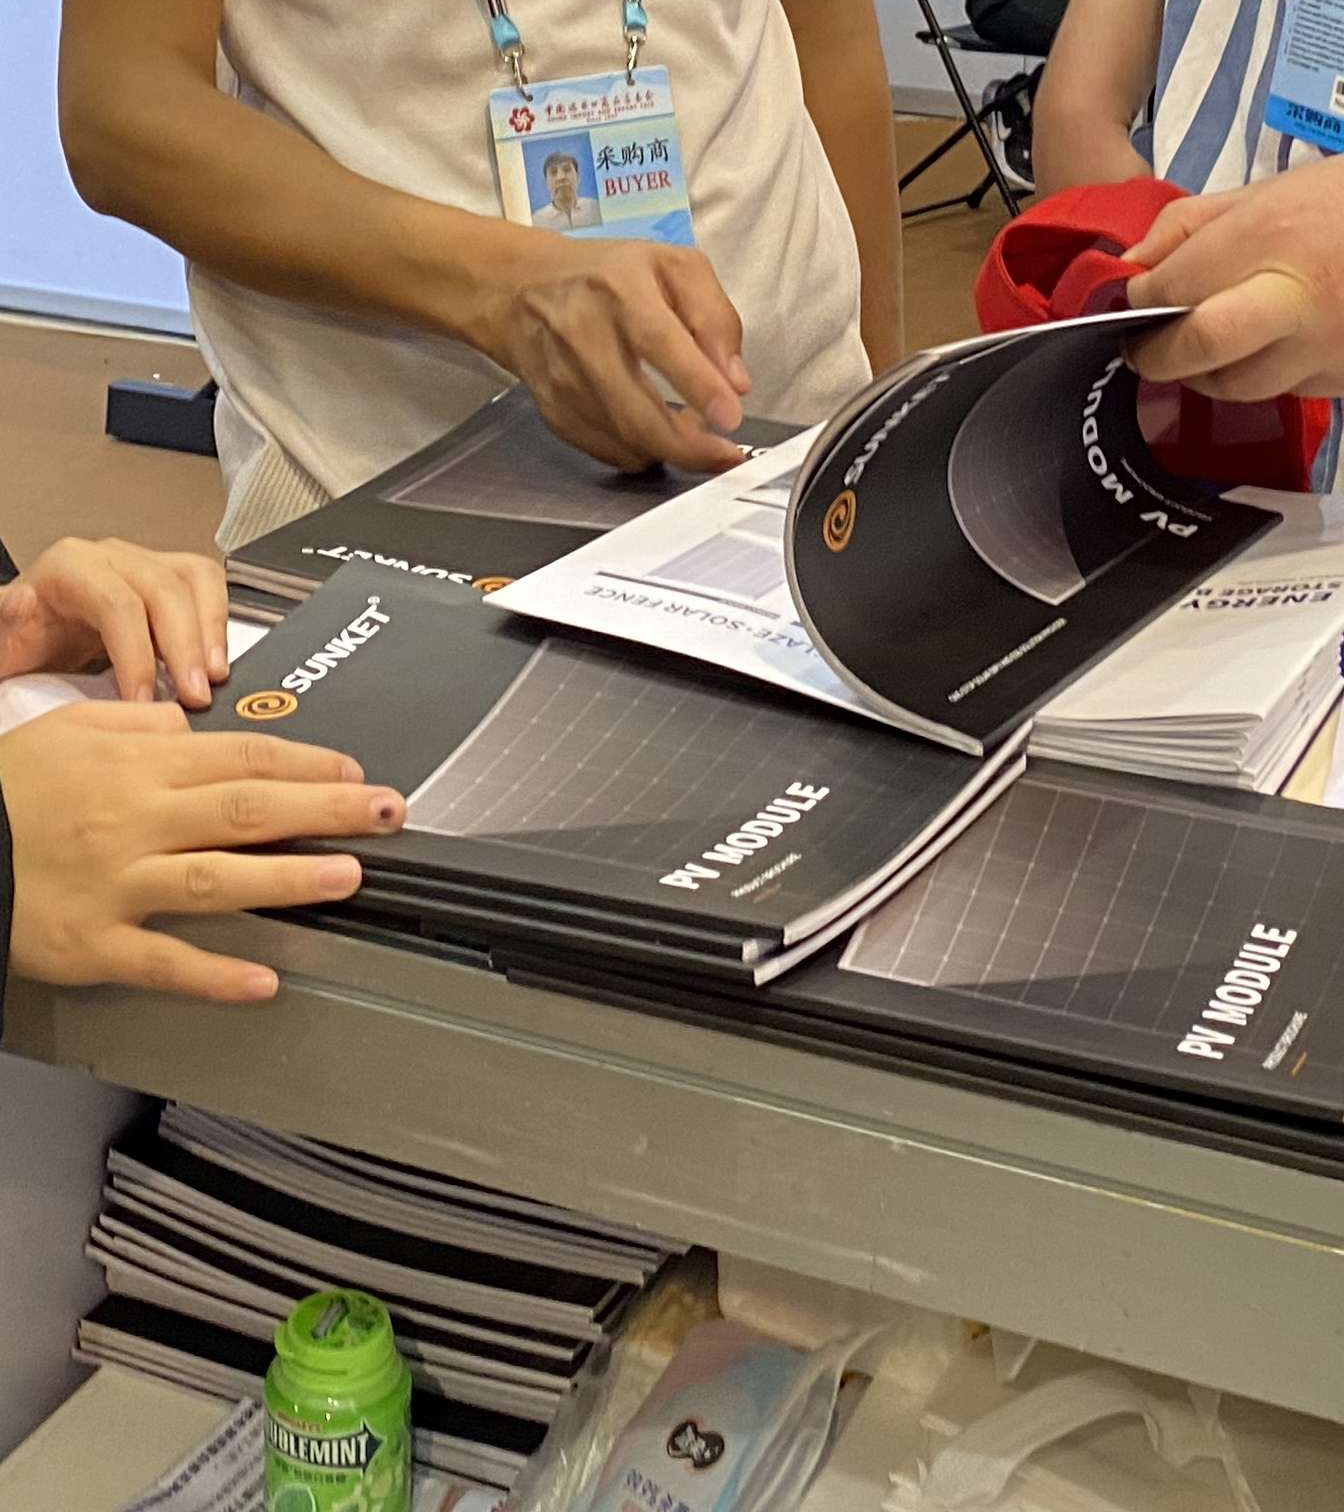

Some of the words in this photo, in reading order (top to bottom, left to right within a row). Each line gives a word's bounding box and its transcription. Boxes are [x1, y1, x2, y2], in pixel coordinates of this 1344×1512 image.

[597, 138, 670, 172] 采购商
[604, 169, 672, 198] BUYER
[1139, 510, 1199, 539] PV
[1179, 591, 1334, 610] ENERGY
[659, 862, 721, 890] PV
[702, 781, 830, 865] MODULE
[1202, 923, 1298, 1026] MODULE
[1177, 1024, 1236, 1060] PV
